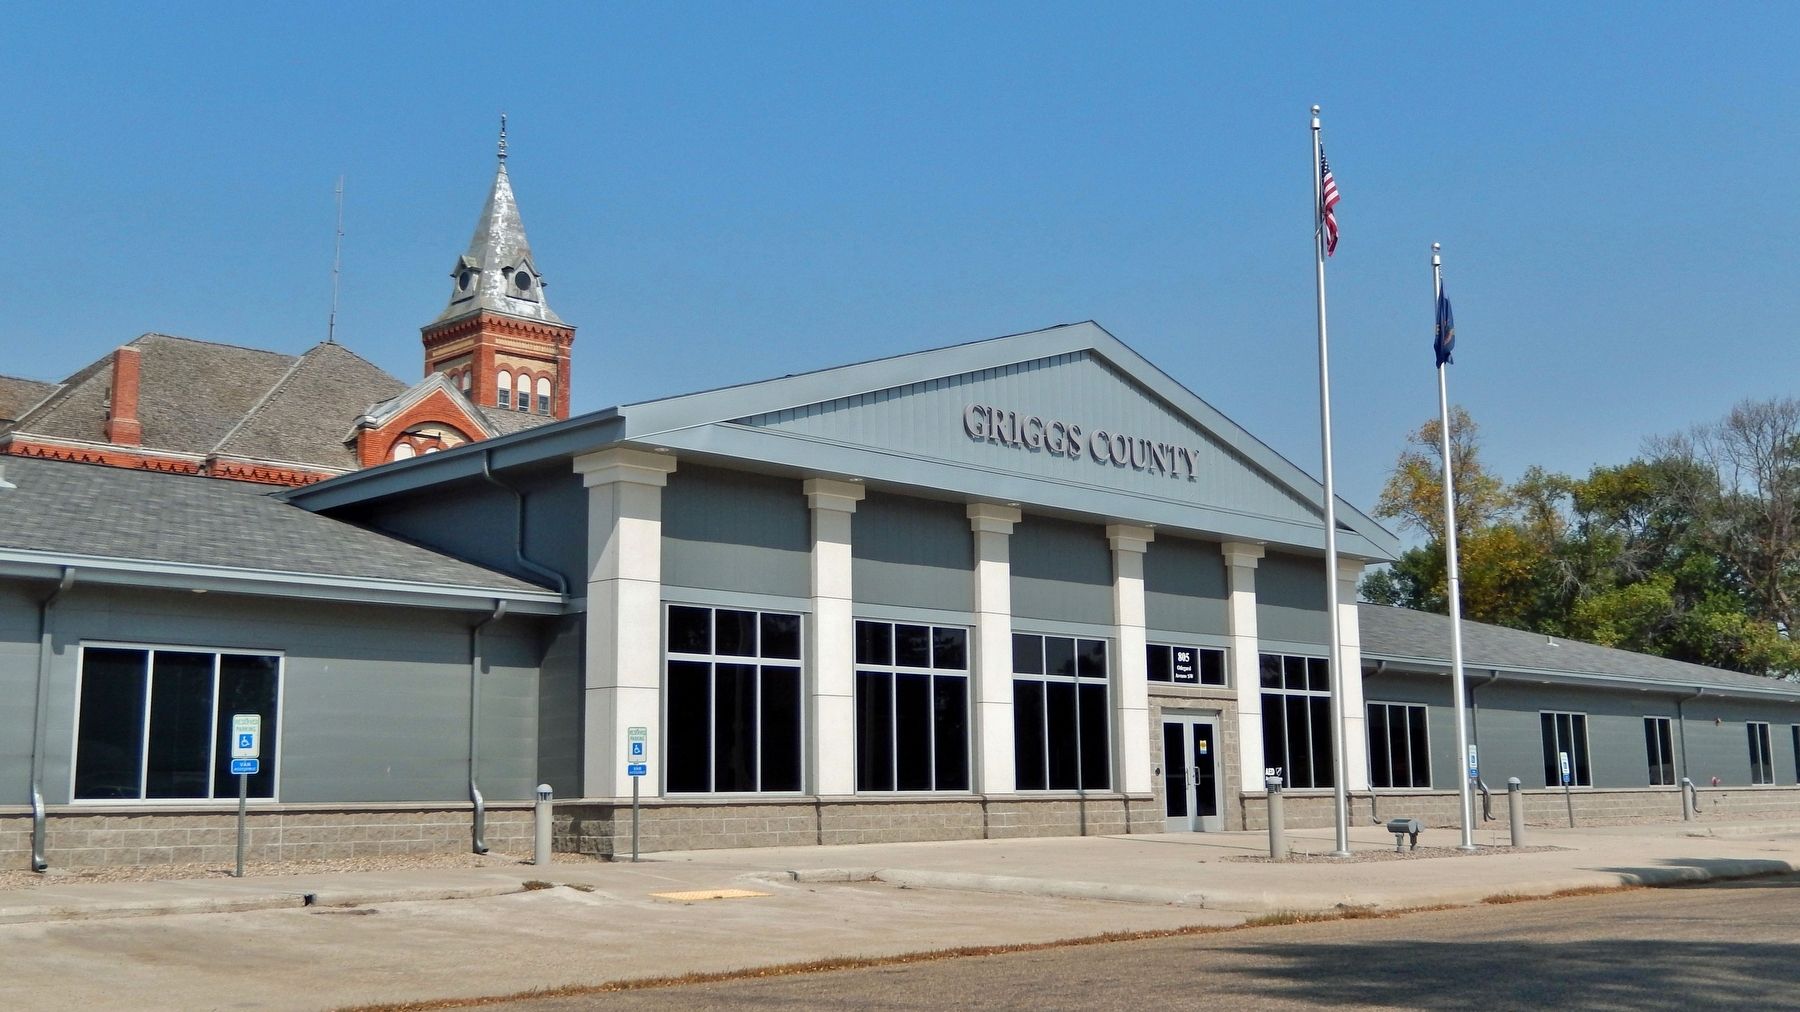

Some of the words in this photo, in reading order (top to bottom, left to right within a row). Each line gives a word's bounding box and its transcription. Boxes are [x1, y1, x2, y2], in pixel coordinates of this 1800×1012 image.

[963, 402, 1082, 459] GRIGGS
[1089, 429, 1200, 478] COUNTY
[1178, 652, 1190, 662] 805
